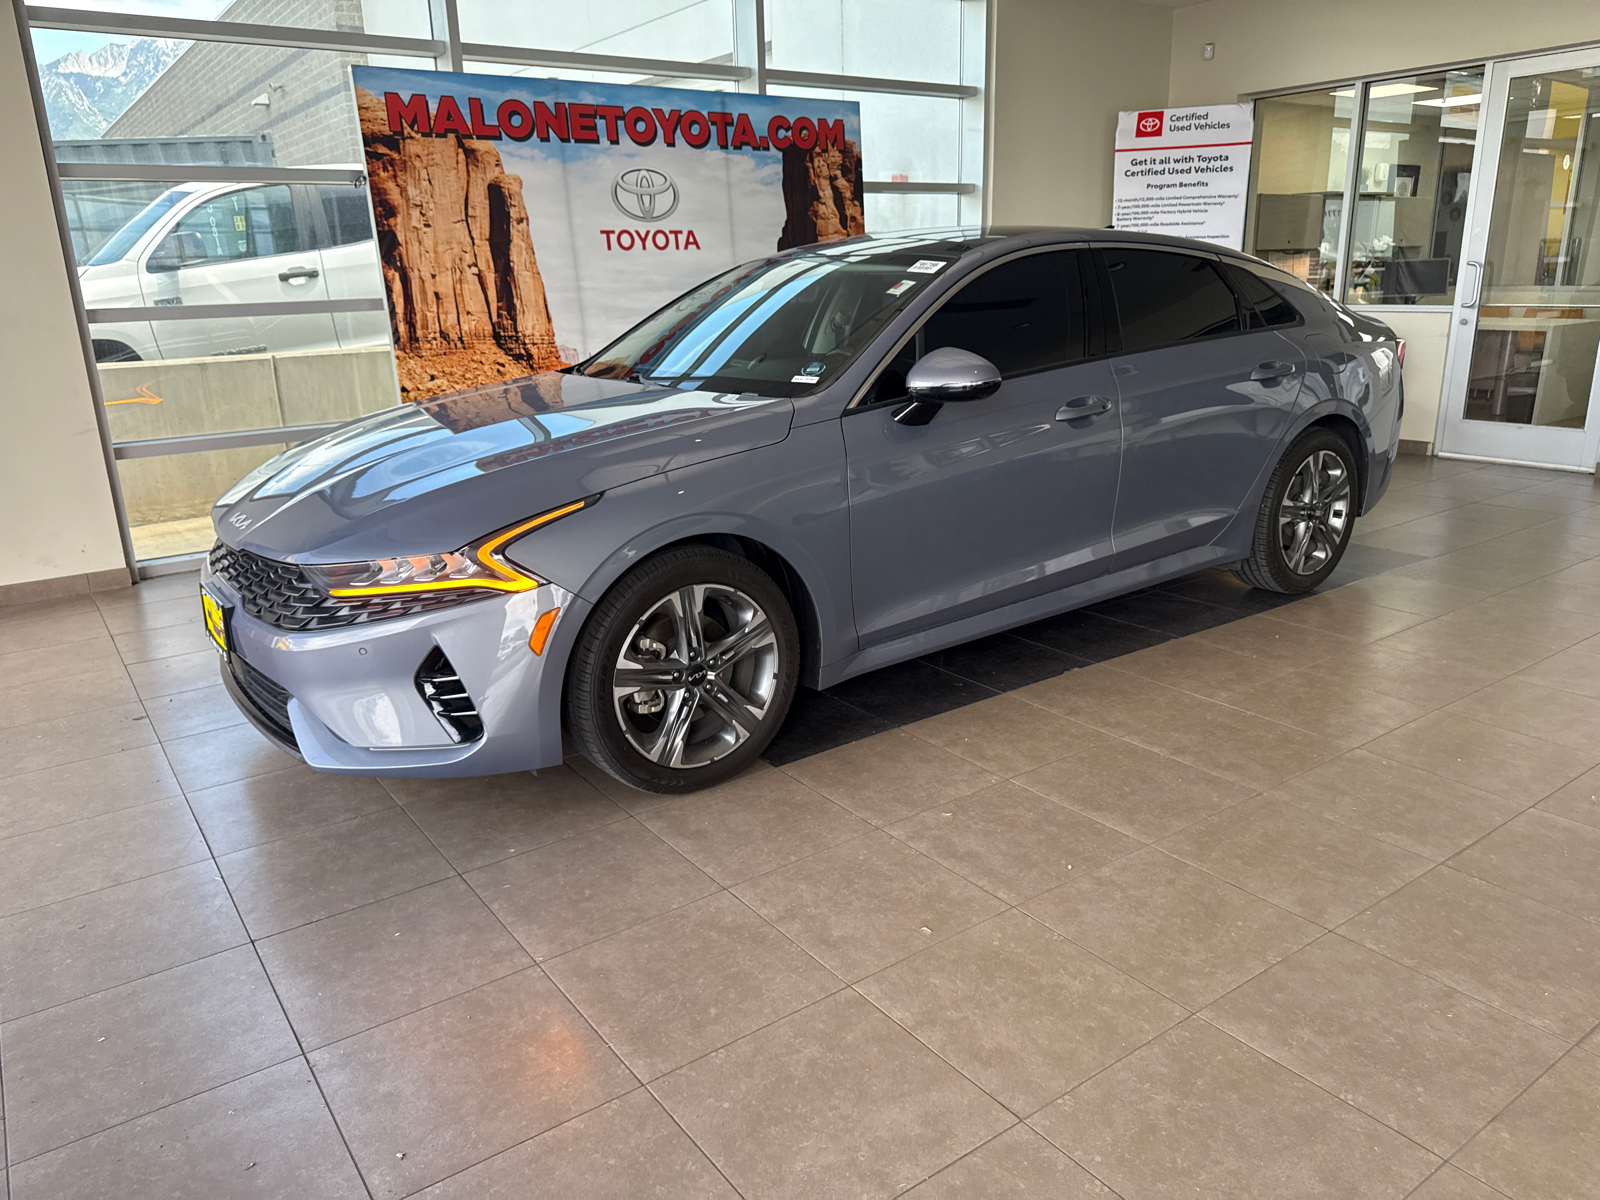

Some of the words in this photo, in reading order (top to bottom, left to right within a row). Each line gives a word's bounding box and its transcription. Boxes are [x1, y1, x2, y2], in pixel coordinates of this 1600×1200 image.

[384, 92, 845, 151] MALONETOYOTA.COM
[1170, 112, 1209, 122] Certified
[1169, 123, 1192, 132] Used
[1194, 121, 1231, 131] Vehicles
[1130, 158, 1148, 166] Get
[1150, 157, 1157, 165] it
[1158, 156, 1171, 165] all
[1173, 155, 1195, 165] with
[1196, 154, 1229, 165] Toyota
[1124, 167, 1166, 177] Certified
[1168, 166, 1192, 175] Used
[1194, 164, 1234, 174] Vehicles
[599, 229, 701, 251] TOYOTA
